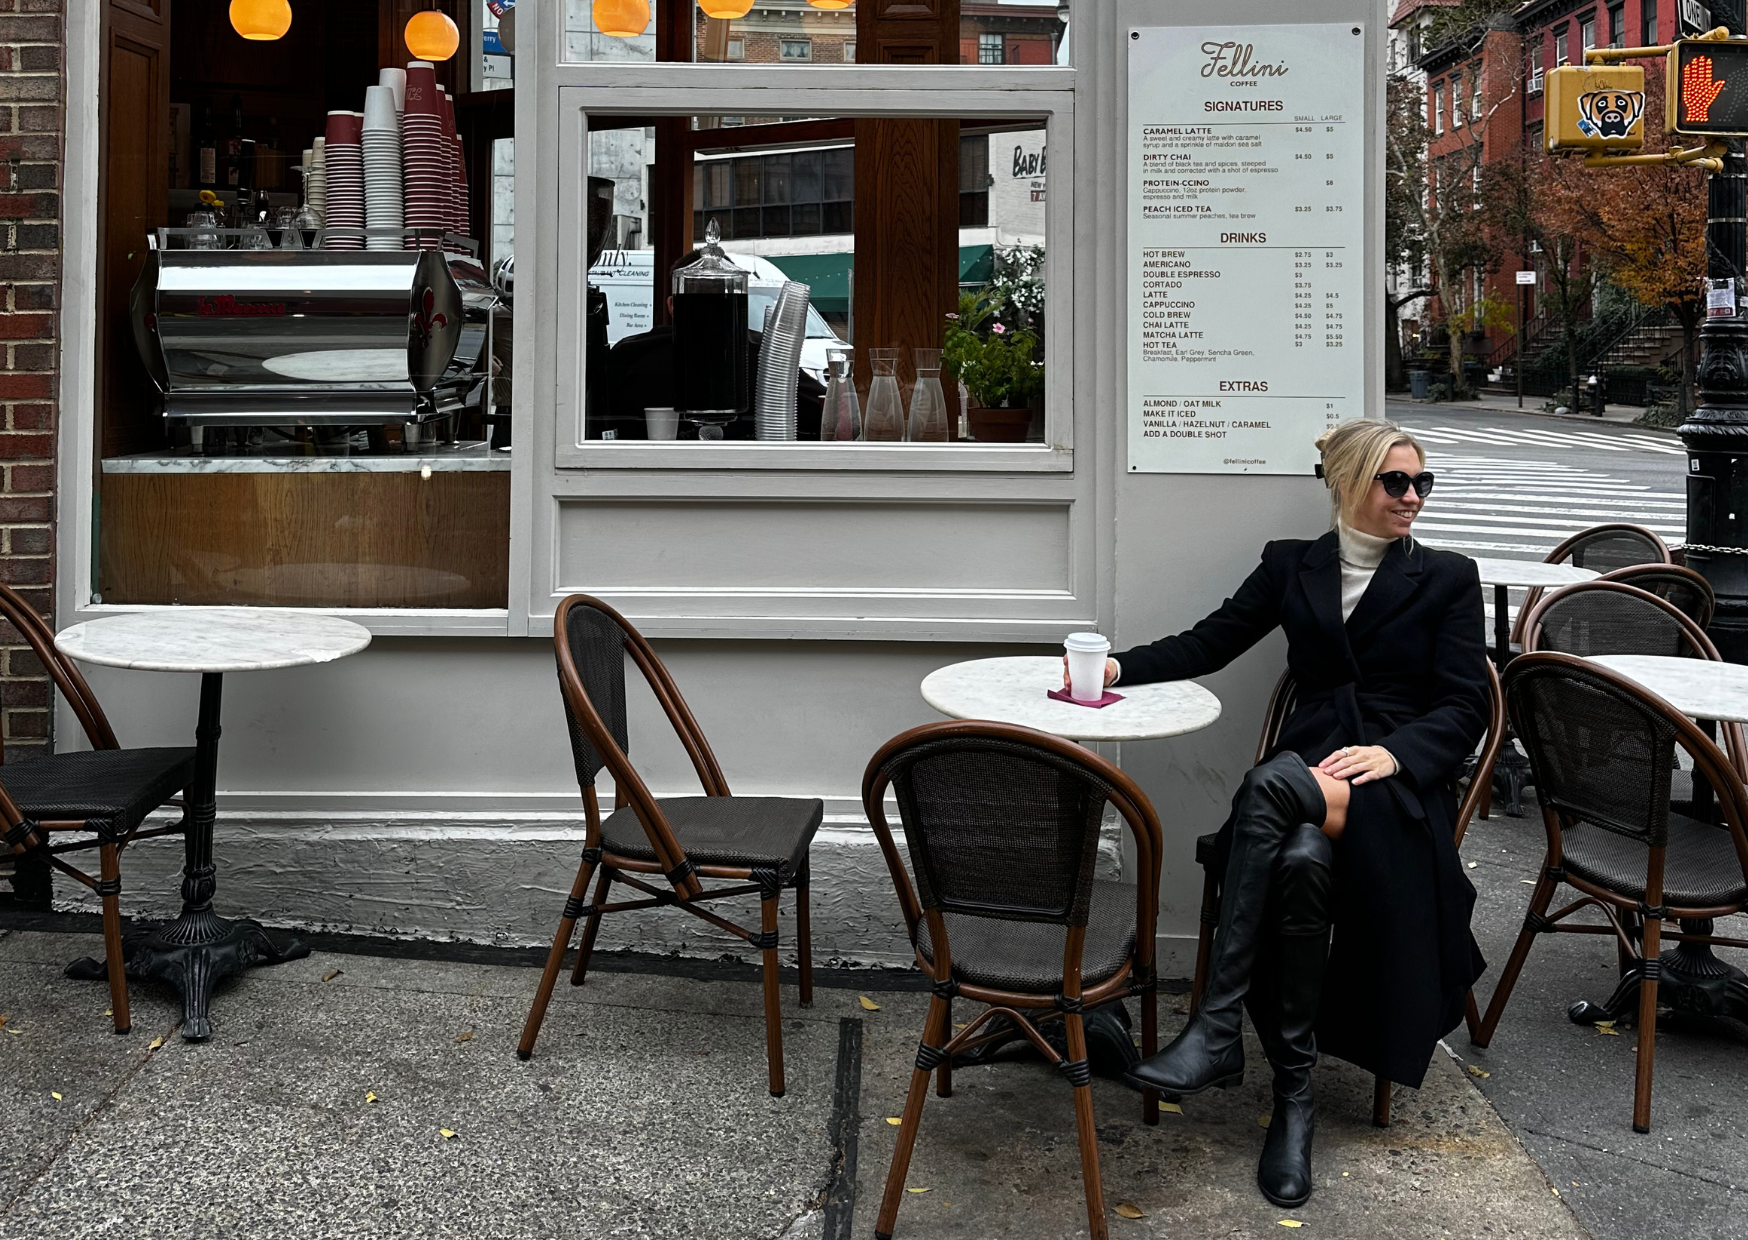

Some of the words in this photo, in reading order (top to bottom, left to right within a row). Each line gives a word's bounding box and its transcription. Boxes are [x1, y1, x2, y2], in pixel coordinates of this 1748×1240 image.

[1201, 42, 1289, 77] Fellini
[1204, 101, 1283, 111] SIGNATURES
[1012, 145, 1040, 177] BABY
[1220, 233, 1266, 243] DRINKS
[1219, 381, 1268, 391] EXTRAS
